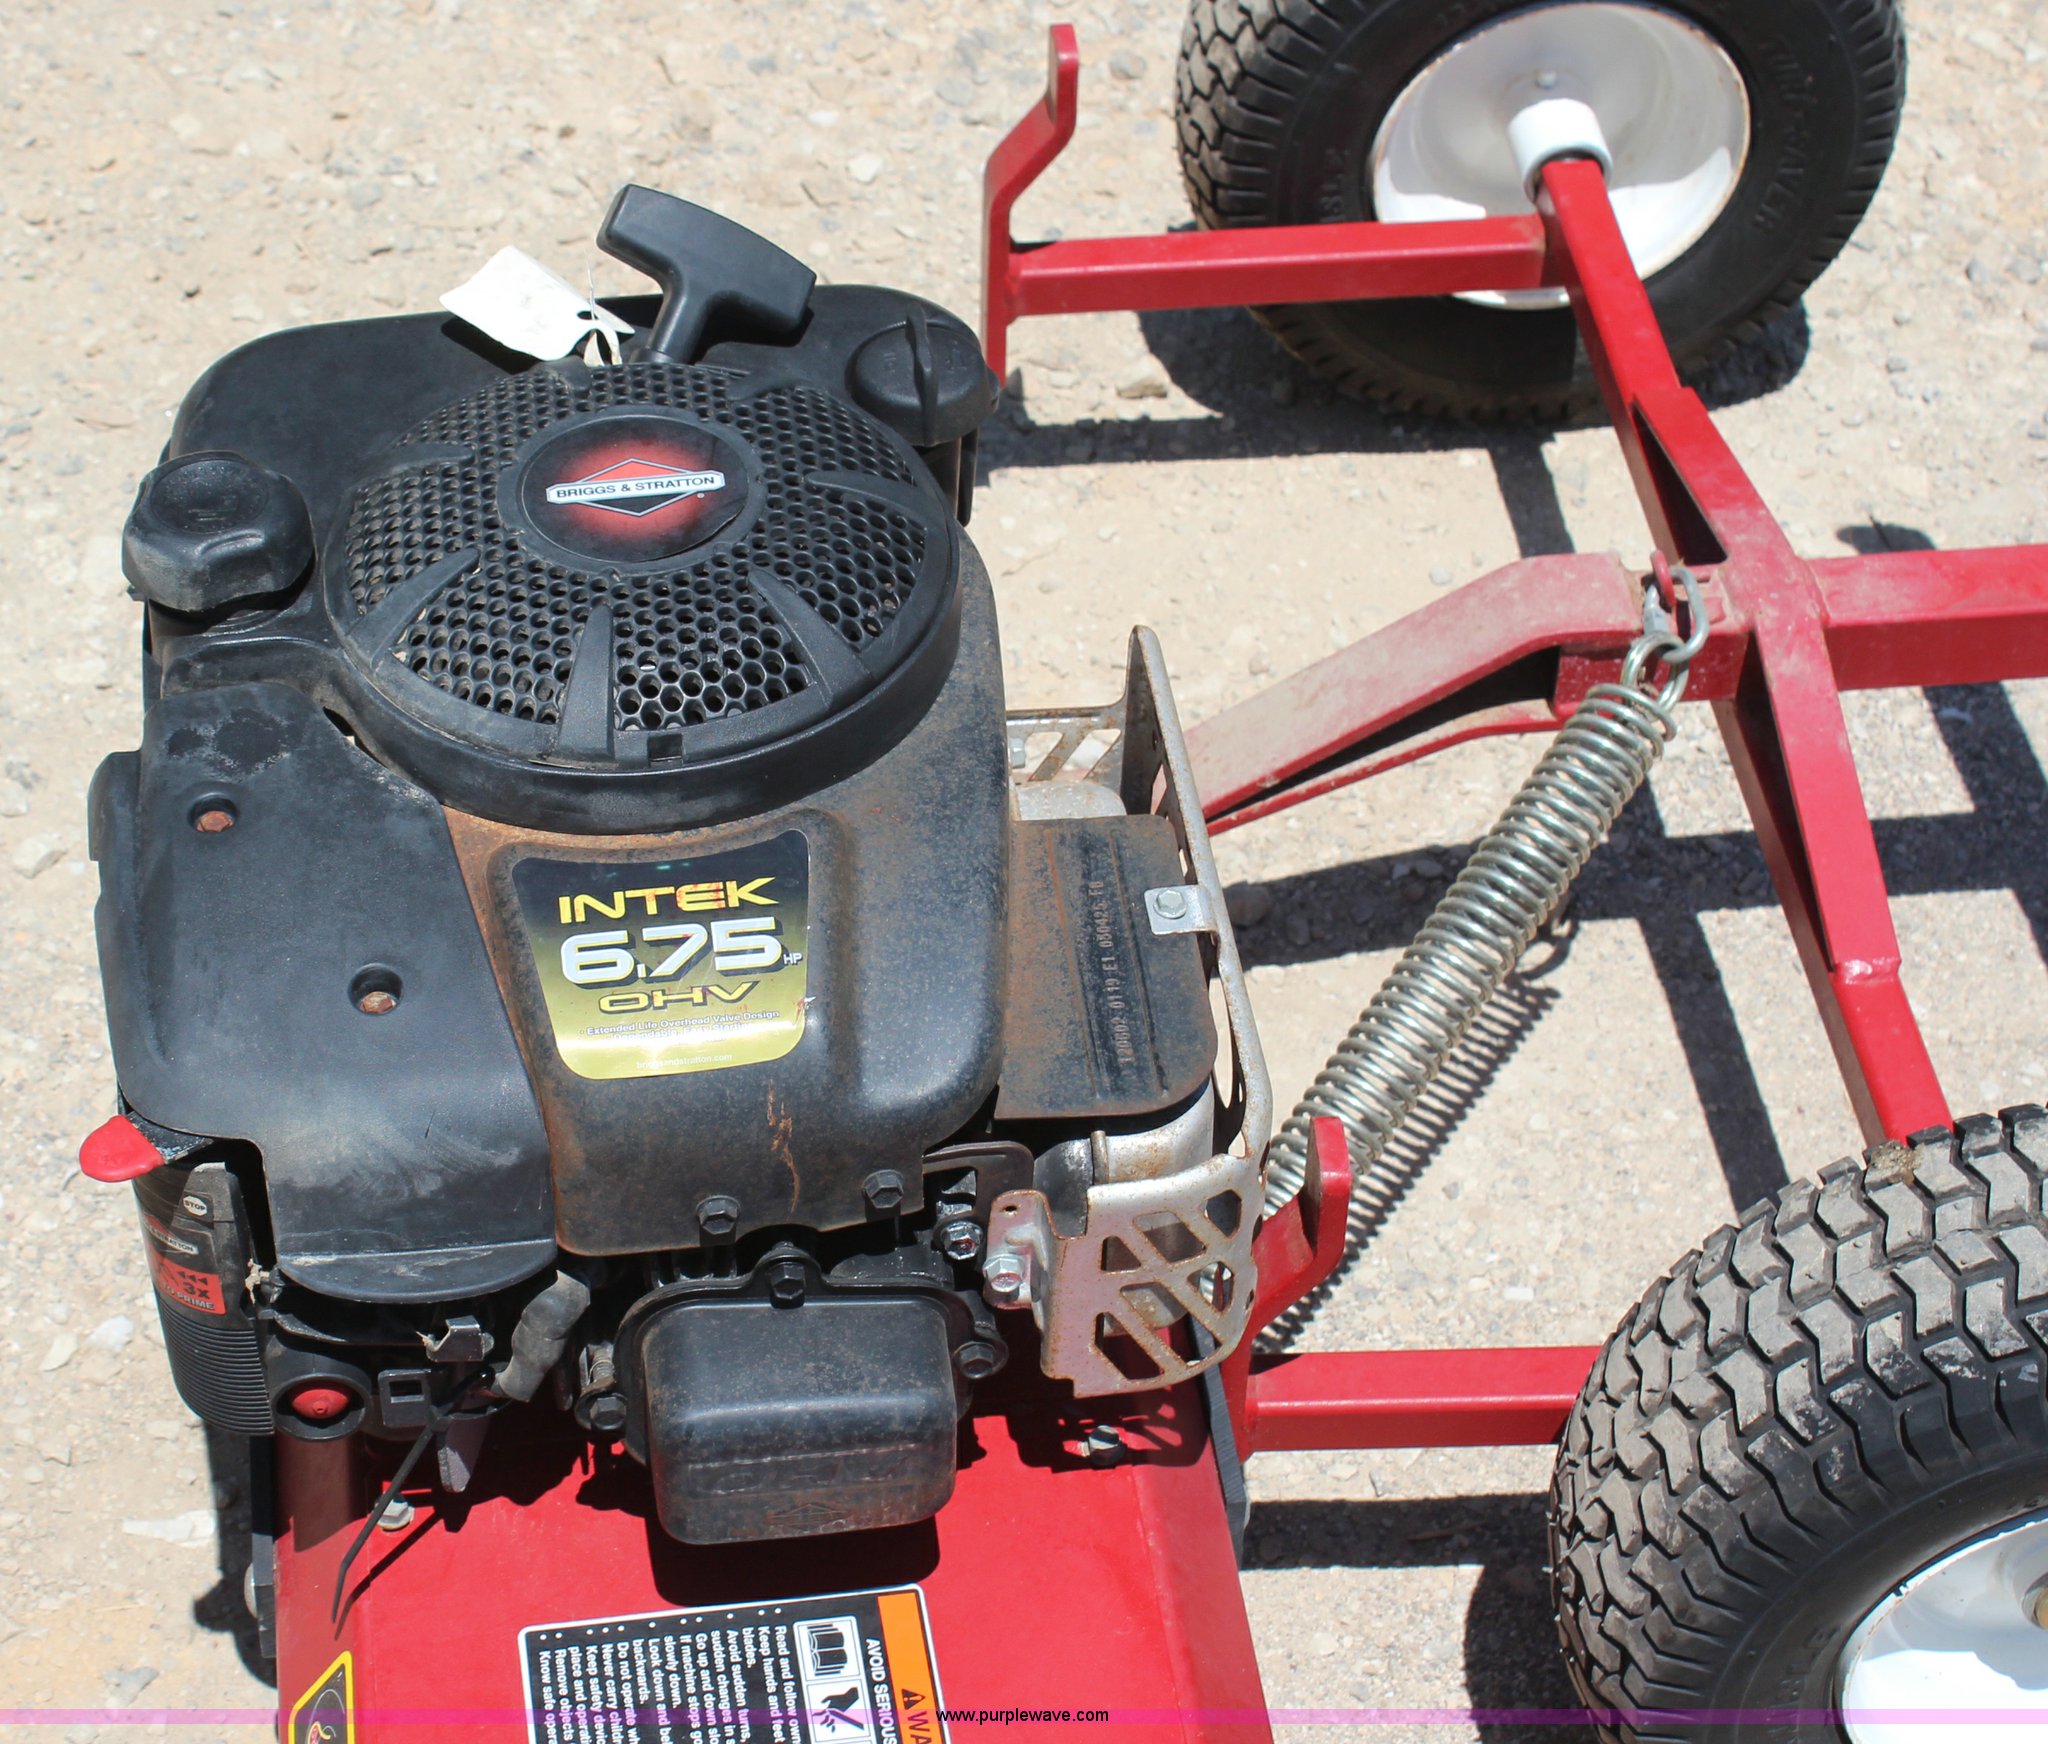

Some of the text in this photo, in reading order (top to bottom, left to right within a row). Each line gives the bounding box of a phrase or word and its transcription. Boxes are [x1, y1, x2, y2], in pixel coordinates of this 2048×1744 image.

[556, 476, 715, 498] BRIGGS & STRATTON
[558, 876, 780, 925] INTEK
[560, 916, 804, 985] 6.75 HP
[598, 980, 760, 1014] OHV
[586, 1010, 780, 1036] Extended Life Overhead Valve Design
[184, 1199, 206, 1211] STOP
[177, 1291, 215, 1310] PRIME
[617, 1642, 629, 1658] Do
[648, 1638, 662, 1667] Look
[680, 1634, 692, 1644] If
[696, 1632, 708, 1650] Go
[711, 1630, 725, 1672] sudden
[742, 1627, 757, 1668] blades.
[775, 1625, 790, 1656] Read
[539, 1650, 551, 1684] Know
[568, 1646, 582, 1677] place
[586, 1645, 598, 1676] Keep
[602, 1644, 614, 1678] Never
[620, 1660, 632, 1680] not
[632, 1638, 650, 1704] backwards.
[664, 1635, 682, 1709] slowly down.
[681, 1645, 697, 1694] machine
[697, 1652, 708, 1668] up
[780, 1657, 794, 1680] and
[555, 1648, 574, 1741] Remove objects
[574, 1679, 587, 1702] and
[590, 1677, 603, 1712] safety
[606, 1679, 618, 1710] carry
[652, 1669, 665, 1702] down
[700, 1670, 714, 1692] and
[726, 1629, 750, 1743] Avoid sudden turns,
[758, 1626, 786, 1743] Keep hands and feet
[866, 1638, 898, 1744] AVOID SERIOUS
[543, 1686, 556, 1710] safe
[620, 1682, 637, 1726] operate
[688, 1696, 700, 1728] stops
[704, 1693, 717, 1726] down
[717, 1674, 732, 1724] changes
[783, 1681, 797, 1717] follow
[656, 1703, 671, 1726] and
[724, 1724, 736, 1737] in
